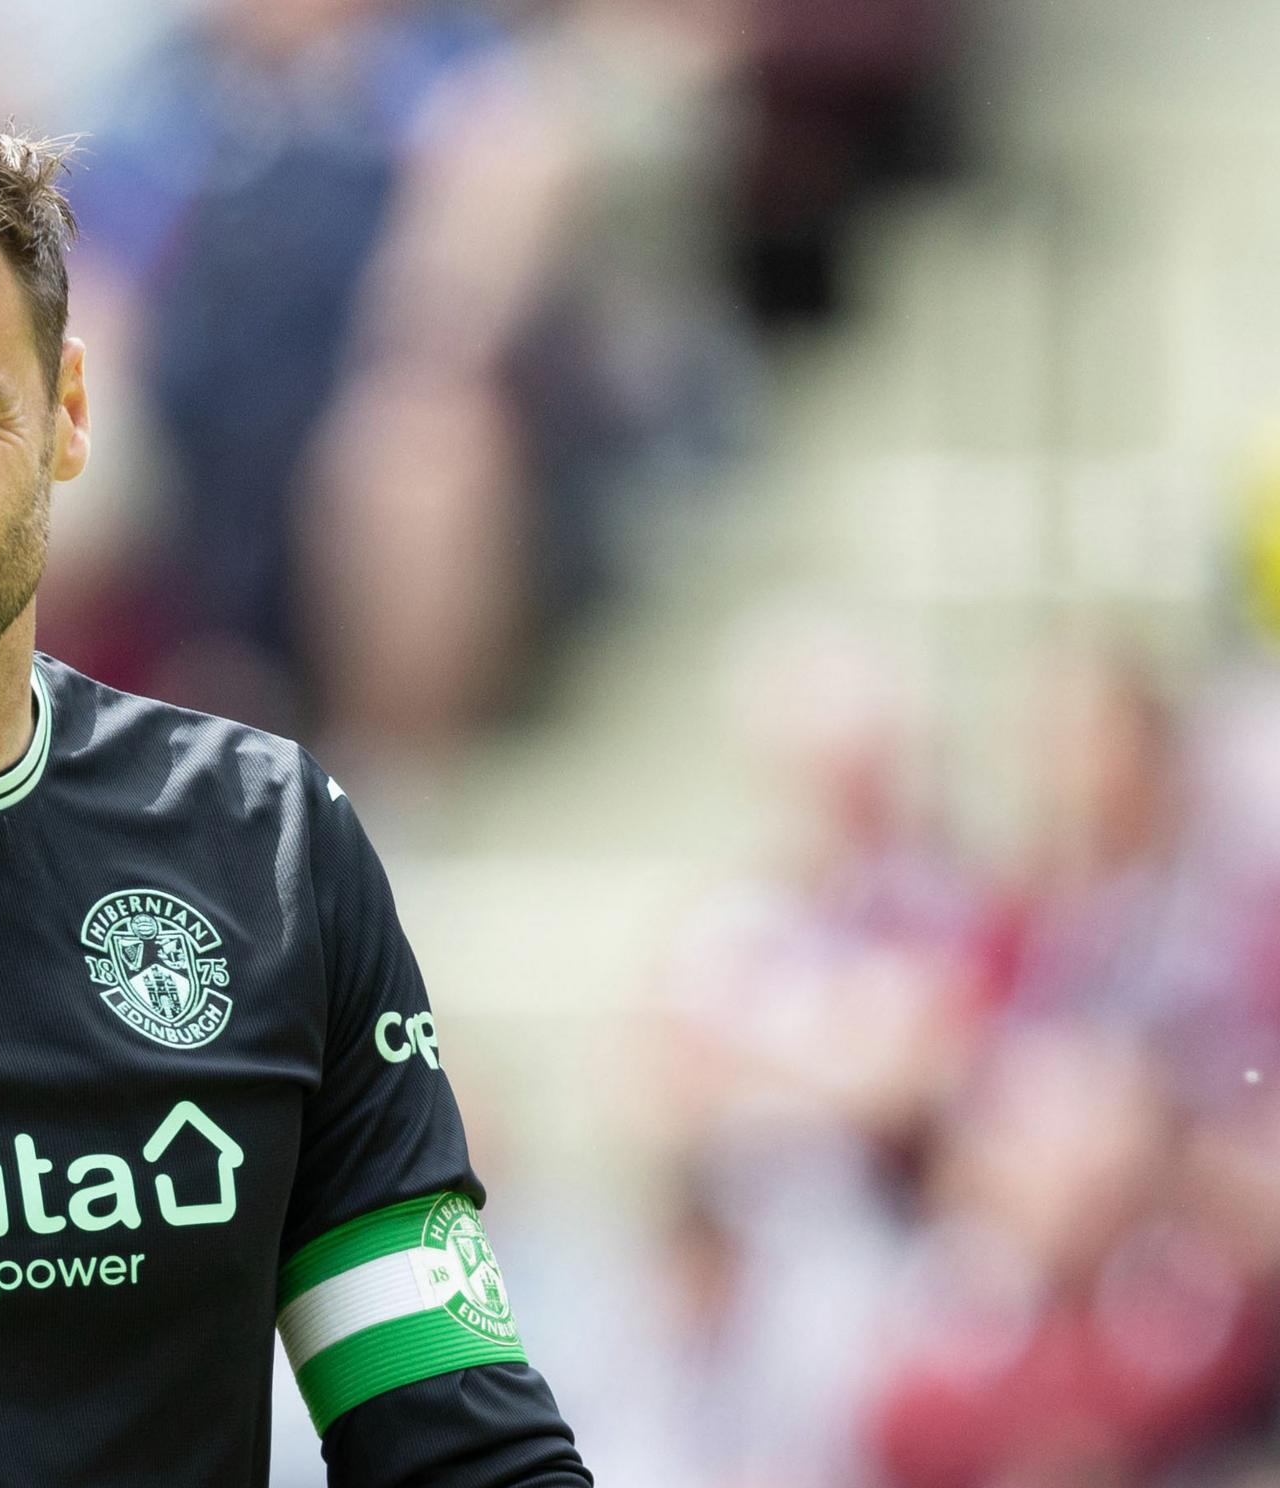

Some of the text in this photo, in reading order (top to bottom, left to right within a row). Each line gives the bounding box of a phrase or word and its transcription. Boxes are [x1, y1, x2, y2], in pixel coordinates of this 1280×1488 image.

[89, 896, 208, 941] HIBERNIAN
[84, 955, 230, 987] 18 75
[117, 1003, 223, 1043] EDINBURGH
